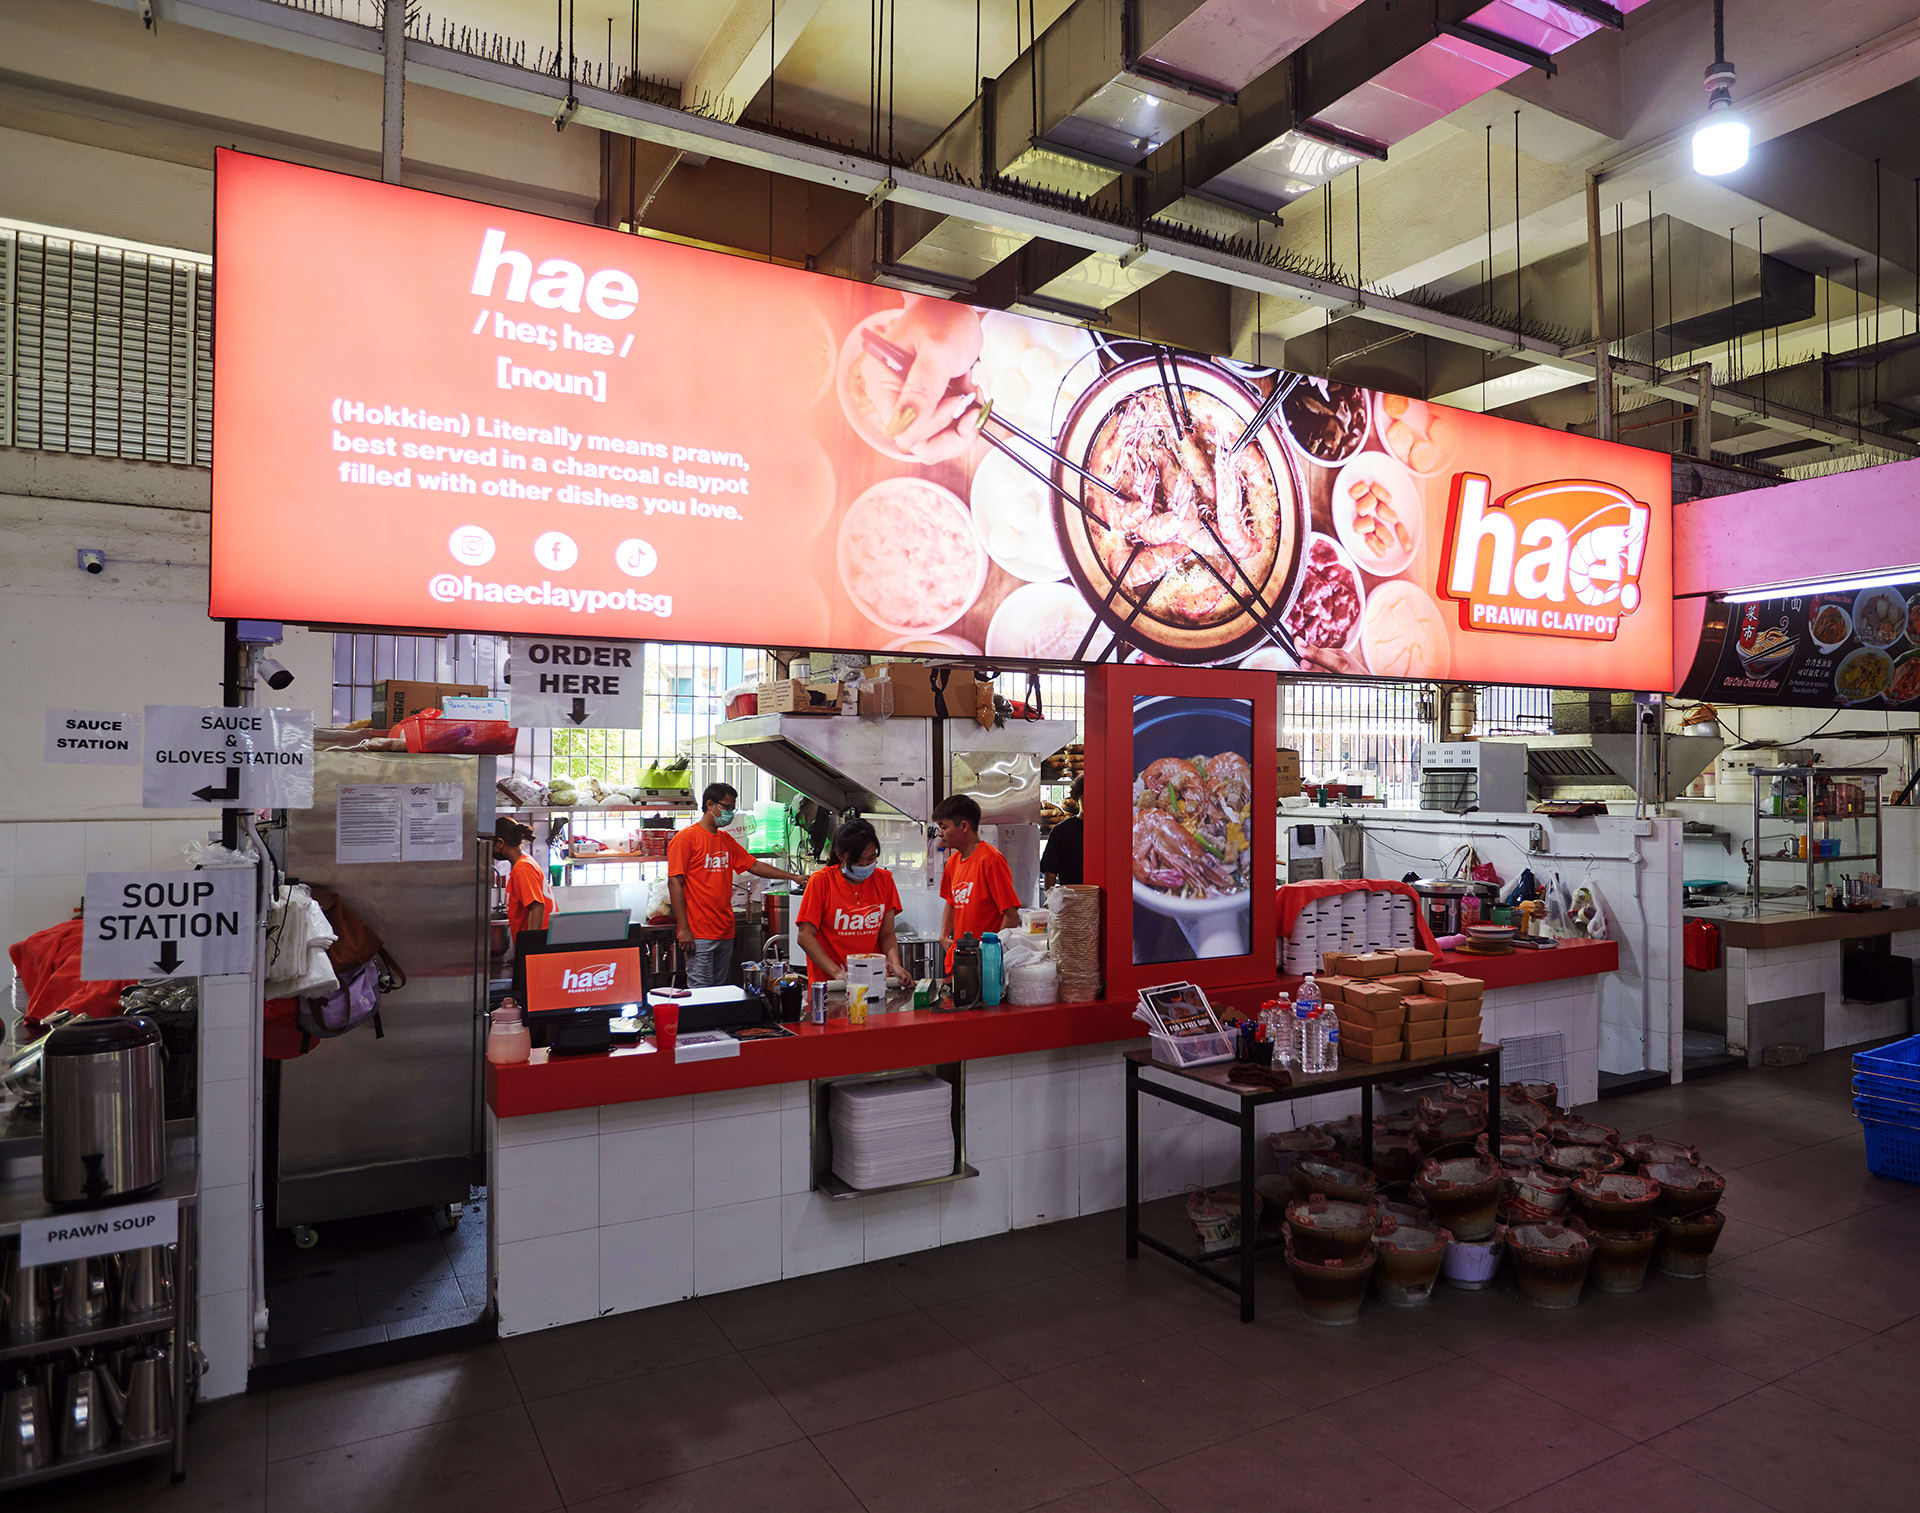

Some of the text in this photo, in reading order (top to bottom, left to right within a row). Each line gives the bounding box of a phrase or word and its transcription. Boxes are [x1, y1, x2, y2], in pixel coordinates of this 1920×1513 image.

[471, 228, 639, 320] hae
[497, 356, 607, 403] [noun]
[332, 398, 750, 472] (Hokkien) Literally means prawn,
[332, 430, 749, 498] best served in a charcoal claypot
[339, 462, 743, 520] filled with other dishes you love.
[428, 574, 672, 617] @haeclaypotsg
[1473, 603, 1616, 634] PRAWN CLAYPOT
[528, 643, 632, 667] ORDER
[540, 674, 619, 695] HERE
[65, 719, 122, 731] SAUCE
[200, 716, 262, 732] SAUCE
[56, 737, 129, 750] STATION
[225, 734, 238, 748] &
[155, 751, 304, 766] GLOVES STATION
[122, 881, 215, 908] SOUP
[98, 911, 240, 941] STATION
[48, 1215, 156, 1242] PRAWN SOUP
